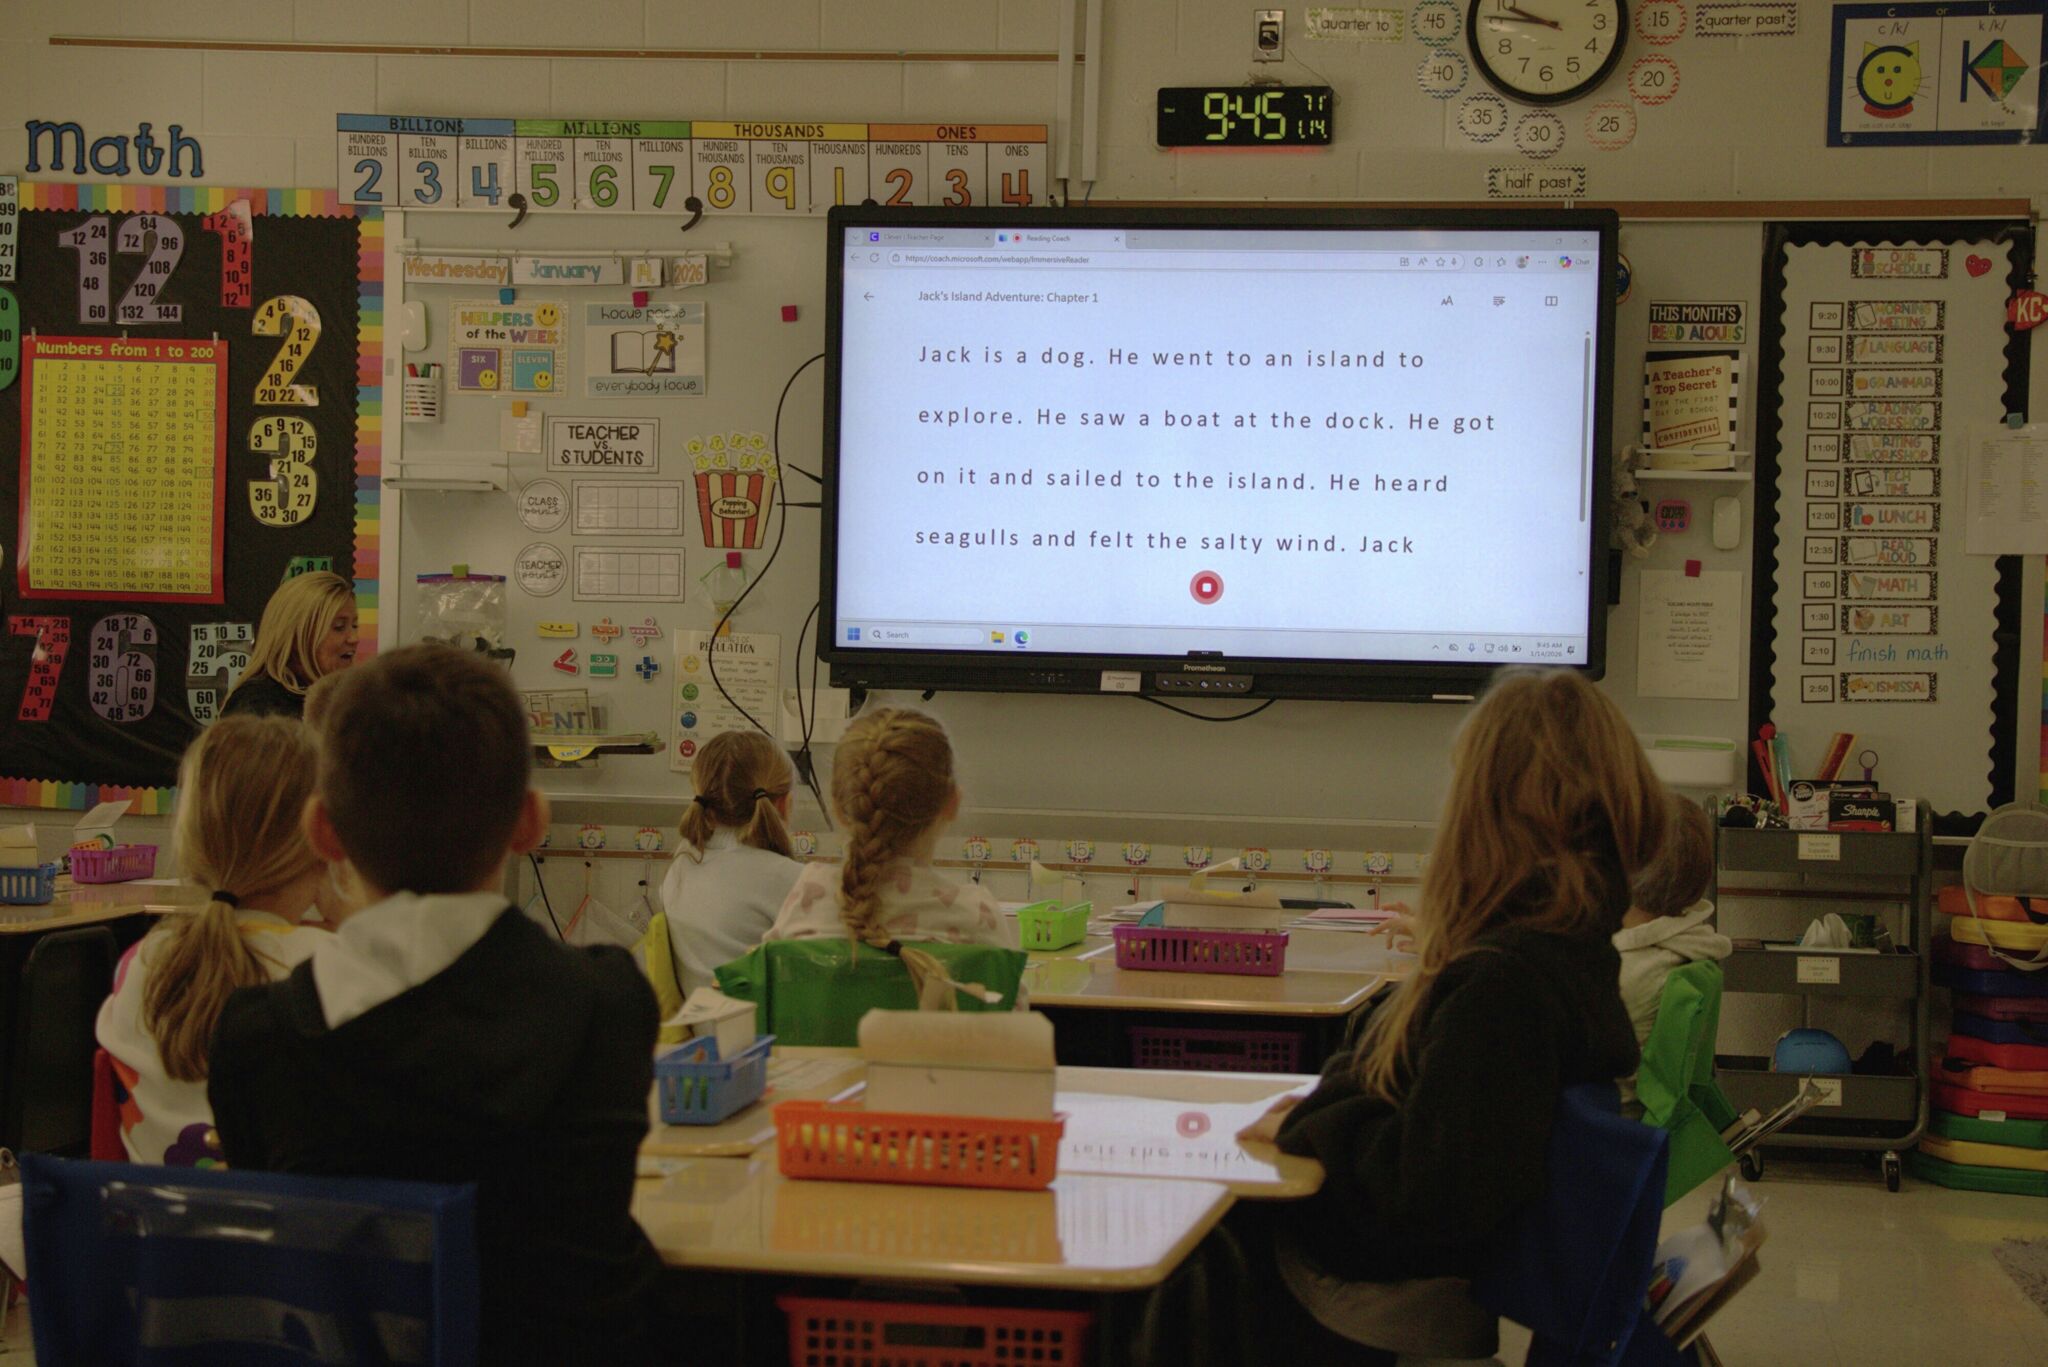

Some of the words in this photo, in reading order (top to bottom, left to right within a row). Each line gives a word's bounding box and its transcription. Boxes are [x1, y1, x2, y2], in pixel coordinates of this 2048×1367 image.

[1321, 18, 1369, 32] quarter
[1376, 20, 1389, 31] to
[1423, 13, 1445, 28] :45
[1649, 11, 1669, 27] :15
[1705, 14, 1751, 28] quarter
[1756, 14, 1786, 27] past
[1640, 71, 1665, 87] :20
[1204, 92, 1286, 140] 9:45
[1470, 109, 1492, 125] :35
[390, 118, 464, 134] BILLIONS
[563, 122, 640, 136] MILLIONS
[734, 124, 824, 138] THOUSANDS
[1597, 117, 1620, 132] :25
[937, 126, 976, 139] ONES
[1526, 126, 1550, 142] :30
[349, 135, 385, 146] HUNDRED
[421, 137, 436, 147] TEN
[465, 139, 507, 150] BILLIONS
[526, 140, 561, 150] HUNDRED
[596, 141, 610, 150] TEN
[703, 141, 738, 151] HUNDRED
[348, 146, 388, 157] BILLIONS
[408, 148, 447, 159] BILLIONS
[639, 142, 683, 153] MILLIONS
[773, 143, 787, 153] TEN
[813, 144, 866, 154] THOUSANDS
[875, 144, 921, 156] HUNDREDS
[946, 145, 968, 156] TENS
[1006, 145, 1028, 156] ONES
[525, 151, 564, 162] MILLIONS
[584, 151, 622, 162] MILLIONS
[698, 153, 744, 164] THOUSANDS
[757, 154, 804, 165] THOUSANDS
[1506, 173, 1532, 189] half
[1539, 176, 1572, 196] past
[73, 231, 86, 244] 12
[91, 226, 106, 239] 24
[1026, 234, 1049, 244] Reading
[1050, 235, 1071, 243] Coach
[124, 234, 139, 247] 72
[90, 252, 106, 265] 36
[1891, 252, 1917, 263] OUR
[406, 258, 507, 283] Wednesday
[531, 260, 601, 282] January
[674, 264, 703, 283] 2026
[1874, 263, 1931, 274] SCHEDULE
[918, 291, 948, 302] Jack's
[951, 291, 983, 302] Island
[985, 291, 1044, 303] Adventure:
[1047, 292, 1089, 305] Chapter
[1092, 293, 1098, 303] 1
[121, 306, 143, 318] 132
[157, 306, 178, 319] 144
[601, 306, 641, 320] hocus
[646, 308, 686, 325] pocus
[1651, 306, 1679, 321] THIS
[1682, 306, 1737, 322] MONTH'S
[1876, 303, 1931, 315] MORNING
[2017, 296, 2042, 322] KC
[461, 312, 533, 327] HELPERS
[1818, 312, 1838, 320] 9:20
[1879, 316, 1926, 328] MEETING
[467, 329, 480, 340] of
[485, 329, 506, 340] the
[510, 330, 559, 344] WEEK
[1652, 326, 1684, 341] READ
[1689, 325, 1742, 341] ALOUDS
[36, 342, 103, 357] Numbers
[110, 344, 147, 358] from
[154, 348, 160, 358] 1
[168, 347, 184, 359] to
[191, 348, 214, 359] 200
[1869, 342, 1934, 353] LANGUAGE
[471, 355, 486, 364] SIX
[518, 355, 548, 364] ELEVEN
[919, 346, 970, 363] Jack
[985, 346, 1002, 363] is
[1017, 350, 1026, 363] a
[1041, 347, 1094, 368] dog.
[1109, 348, 1138, 365] He
[1153, 350, 1213, 365] went
[1227, 351, 1251, 366] to
[1265, 352, 1293, 366] an
[1307, 350, 1385, 367] island
[1400, 352, 1423, 368] to
[1652, 372, 1661, 382] A
[1664, 366, 1722, 381] Teacher's
[596, 381, 660, 395] everybody
[664, 379, 697, 391] focus
[1655, 385, 1676, 396] Top
[1679, 380, 1718, 391] Secret
[1815, 378, 1839, 386] 10:00
[1869, 377, 1933, 388] GRAMMAR
[1869, 402, 1922, 414] READING
[919, 407, 1022, 427] explore.
[1038, 409, 1066, 425] He
[1080, 412, 1125, 426] saw
[1139, 413, 1149, 426] a
[1165, 410, 1220, 427] boat
[1234, 412, 1257, 428] at
[1271, 411, 1311, 428] the
[1325, 412, 1394, 430] dock.
[1409, 413, 1440, 430] He
[1453, 415, 1495, 434] got
[1861, 416, 1929, 429] WORKSHOP
[568, 425, 640, 440] TEACHER
[1657, 423, 1718, 443] CONFIDENTIAL
[302, 436, 315, 449] 15
[561, 450, 643, 465] STUDENTS
[294, 474, 309, 488] 24
[917, 471, 945, 484] on
[959, 467, 976, 484] it
[990, 469, 1033, 485] and
[1046, 470, 1122, 487] sailed
[1136, 472, 1160, 487] to
[1174, 471, 1214, 488] the
[1228, 472, 1315, 490] island.
[1330, 474, 1360, 491] He
[1374, 474, 1448, 492] heard
[1812, 512, 1835, 520] 12:00
[1879, 511, 1926, 523] LUNCH
[915, 528, 1019, 548] seagulls
[1032, 530, 1075, 547] and
[1089, 530, 1134, 548] felt
[1147, 532, 1187, 549] the
[1201, 533, 1262, 554] salty
[1277, 535, 1346, 552] wind.
[1359, 536, 1414, 553] Jack
[1882, 540, 1914, 551] READ
[1878, 552, 1916, 563] ALOUD
[1878, 579, 1918, 592] MATH
[105, 619, 119, 632] 18
[193, 628, 207, 641] 15
[886, 631, 909, 640] Search
[1811, 647, 1829, 655] 2:10
[1847, 640, 1896, 661] finish
[1907, 644, 1948, 661] math
[1183, 664, 1226, 673] Promethean
[1840, 804, 1880, 818] Sharpie
[970, 844, 983, 857] 13
[1130, 844, 1144, 857] 16
[1249, 853, 1263, 866] 18
[1310, 852, 1323, 866] 19
